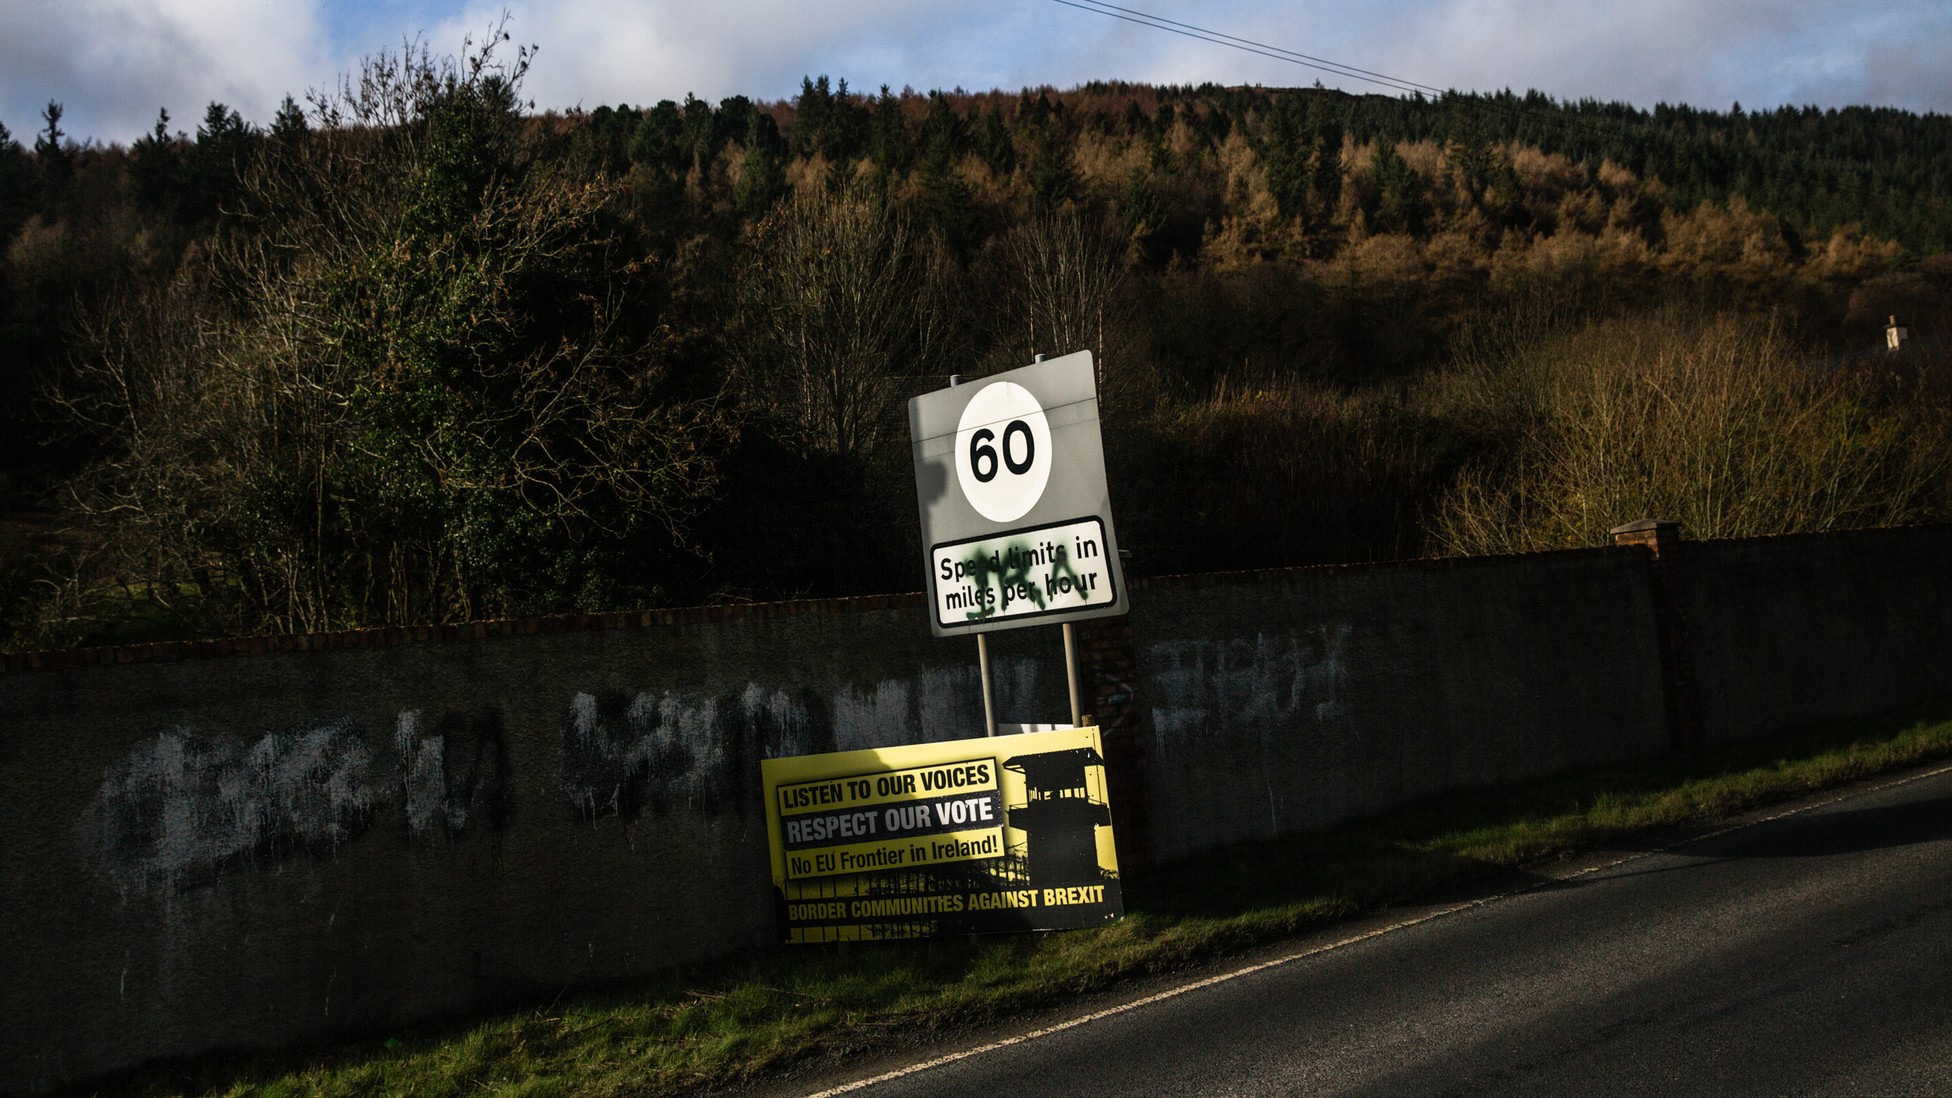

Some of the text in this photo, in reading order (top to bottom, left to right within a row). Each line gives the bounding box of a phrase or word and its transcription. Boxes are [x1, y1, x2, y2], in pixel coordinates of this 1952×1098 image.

[970, 419, 1035, 484] 60
[941, 535, 1098, 582] Sped limits in
[946, 572, 1098, 610] miles per hour
[783, 764, 990, 809] LISTEN TO OUR VOICES
[787, 797, 994, 843] RESPECT OUR VOTE
[791, 835, 998, 875] No EU Frontier in Ireland!
[788, 885, 1105, 921] BORDER COMMUNITIES AGAINST BREXIT
